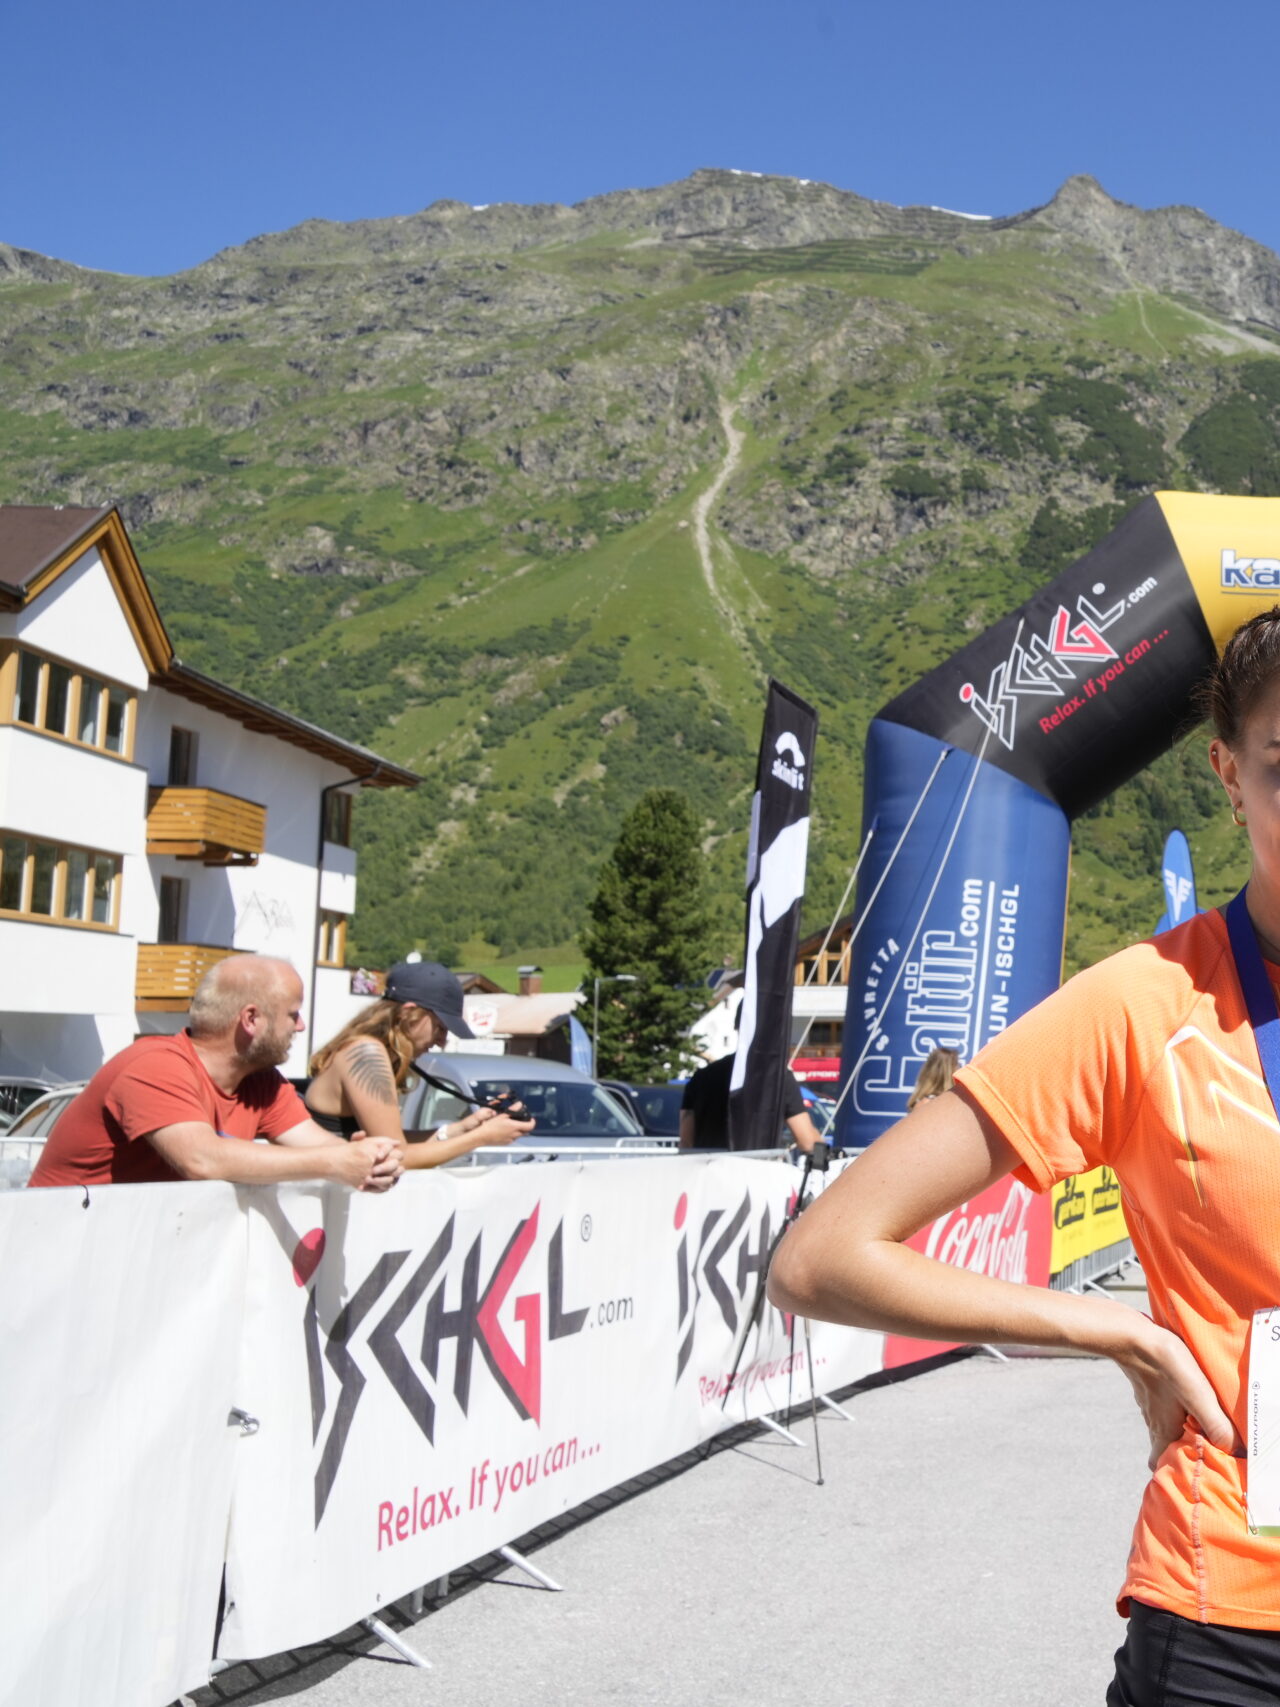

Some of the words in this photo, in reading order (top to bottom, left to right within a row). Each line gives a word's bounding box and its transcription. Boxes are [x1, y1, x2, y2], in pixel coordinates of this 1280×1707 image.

[1038, 697, 1086, 734] Relax.
[1082, 681, 1097, 699] If
[1096, 660, 1126, 693] you
[377, 1486, 461, 1552] Relax.
[469, 1458, 490, 1511] If
[493, 1455, 540, 1513] you
